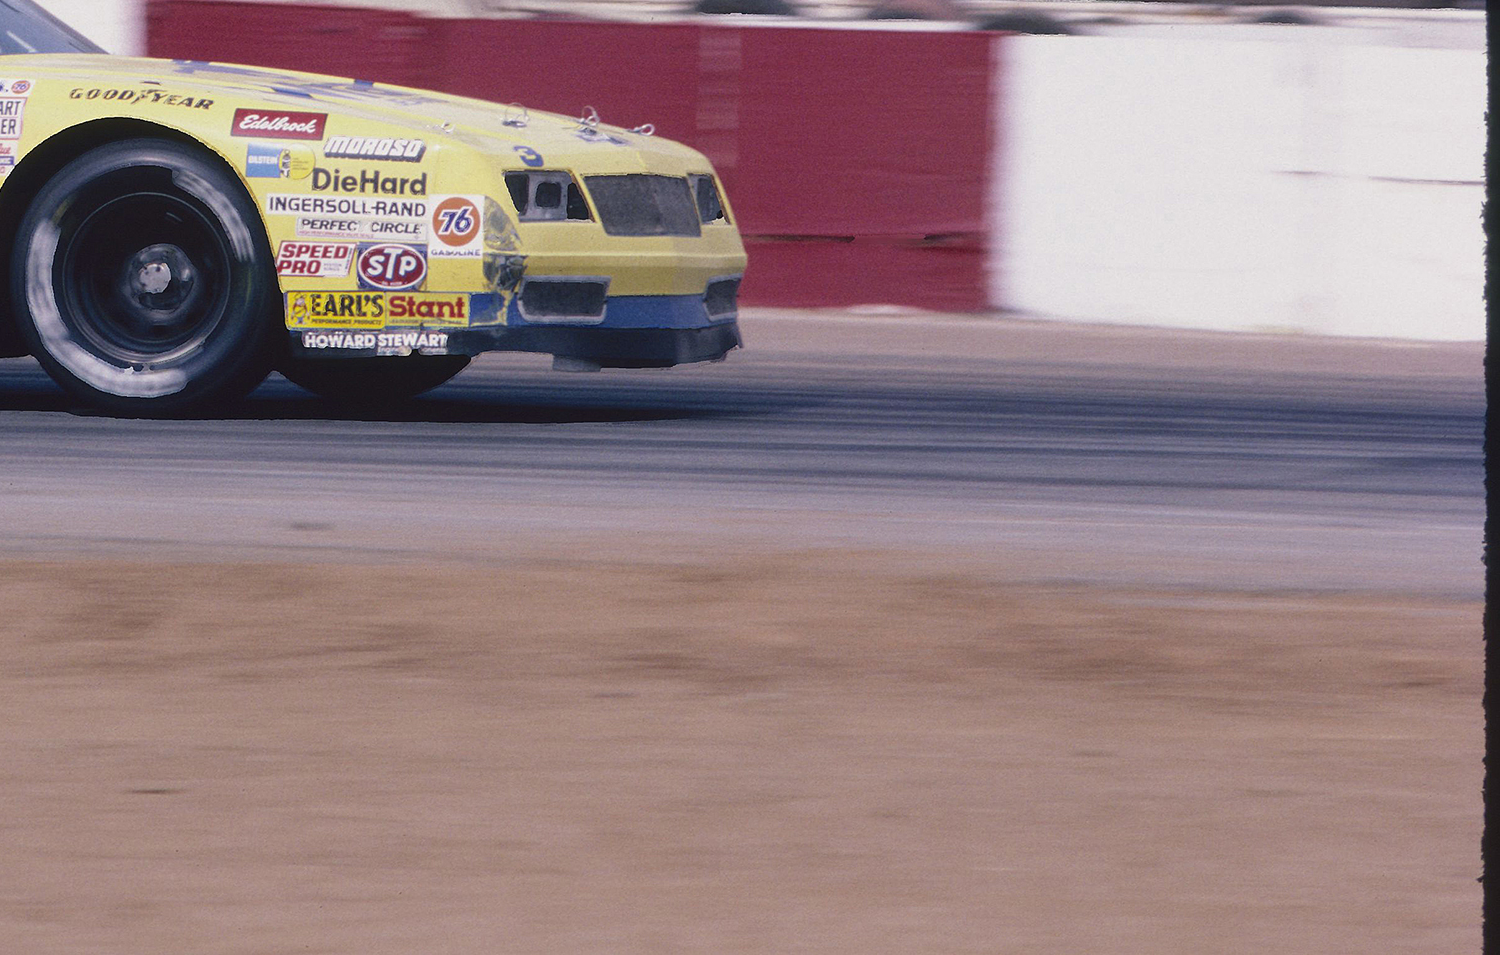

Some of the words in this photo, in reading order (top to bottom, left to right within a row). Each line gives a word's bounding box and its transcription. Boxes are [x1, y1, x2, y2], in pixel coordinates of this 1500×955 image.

[238, 114, 317, 135] Edelbrock
[513, 145, 545, 167] 3
[311, 167, 427, 196] DieHard
[268, 196, 426, 218] INGERSOLL-RAND
[301, 218, 359, 232] PERFEC
[371, 221, 422, 235] CIRCLE
[439, 206, 474, 235] 76
[281, 243, 349, 259] SPEED
[430, 248, 481, 256] GASOLINE
[277, 260, 321, 274] PRO
[366, 248, 417, 280] STP
[311, 294, 384, 318] EARL'S
[389, 295, 465, 318] Stant
[304, 333, 376, 348] HOWARD
[377, 333, 448, 347] STEWART
